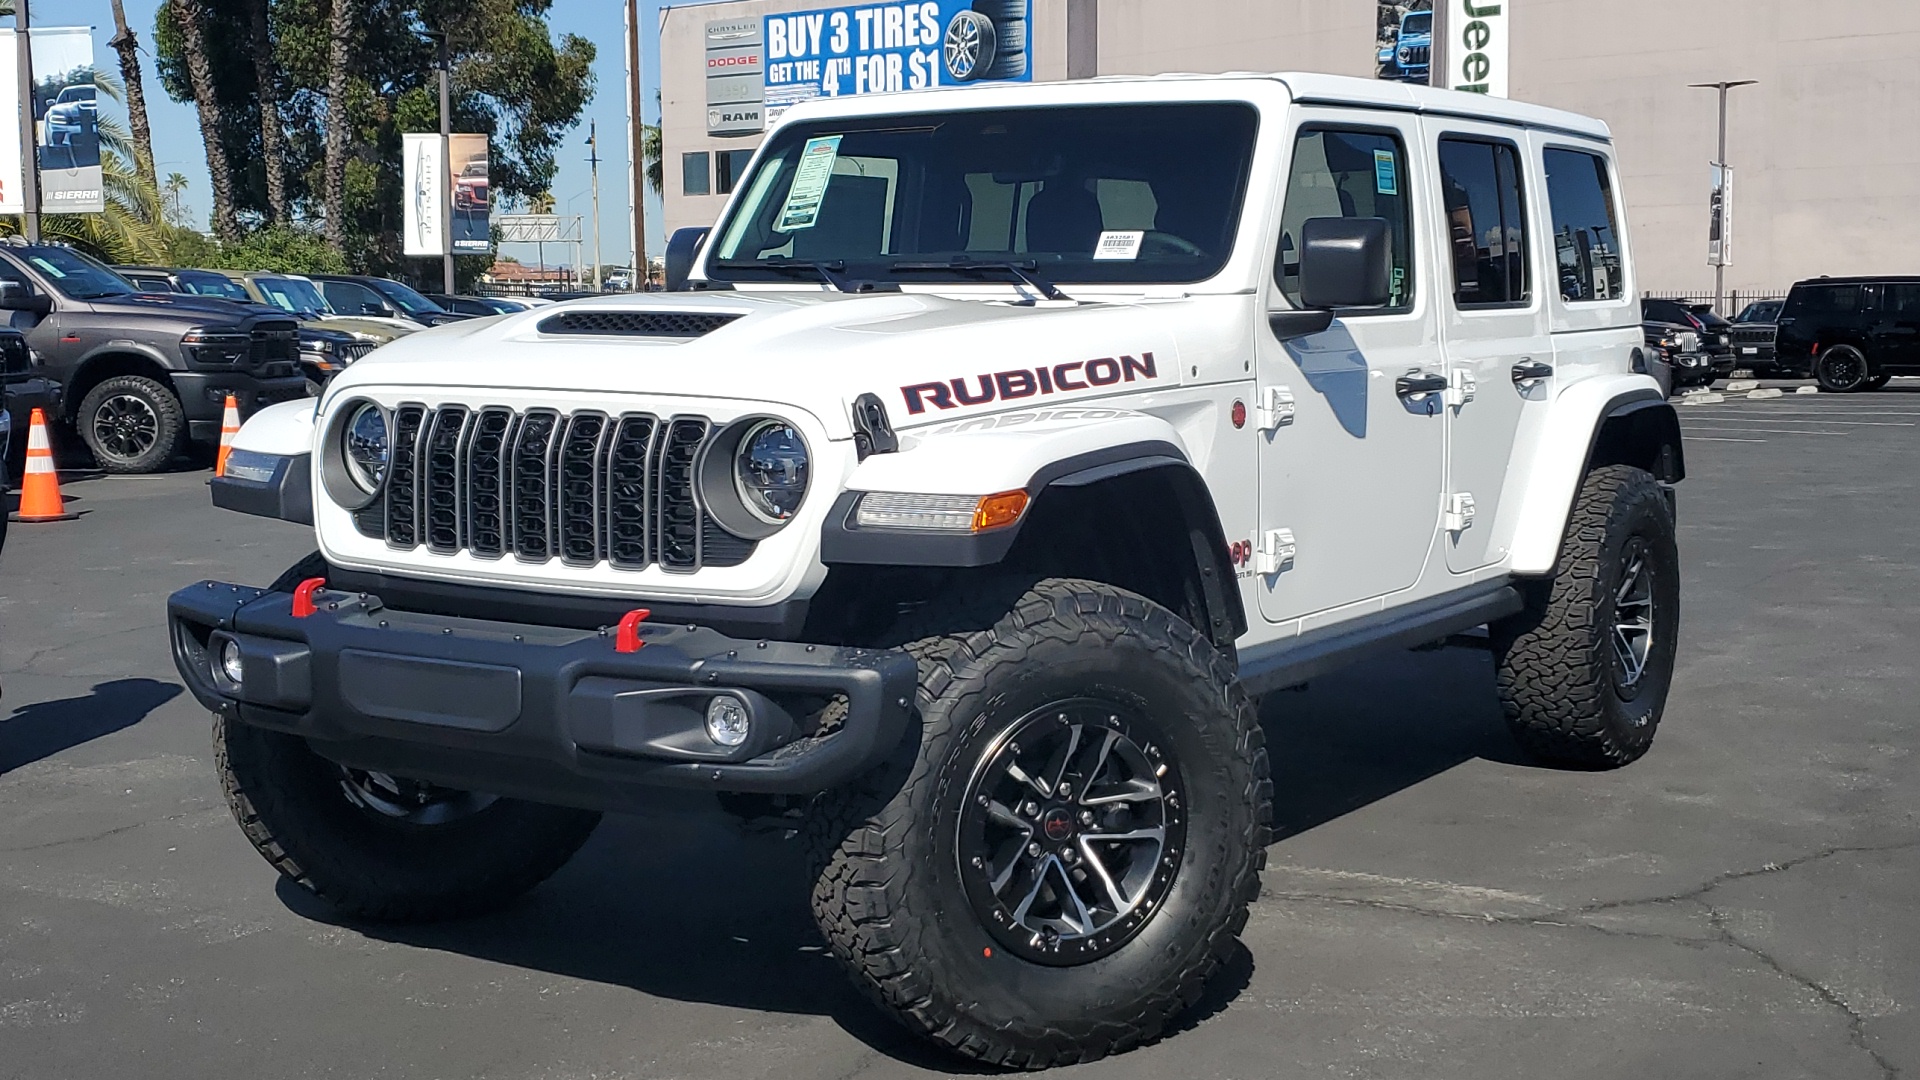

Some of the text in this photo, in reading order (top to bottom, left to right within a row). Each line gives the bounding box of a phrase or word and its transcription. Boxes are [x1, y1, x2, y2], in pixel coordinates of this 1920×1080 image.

[708, 23, 756, 33] CHRYSLER
[768, 2, 939, 59] BUY 3 TIRES
[708, 56, 758, 67] DODGE
[769, 62, 793, 83] GET
[795, 60, 819, 81] THE
[856, 53, 902, 94] FOR
[909, 48, 939, 90] $1
[722, 112, 759, 122] RAM
[54, 190, 99, 200] SIERRA
[900, 352, 1158, 415] RUBICON
